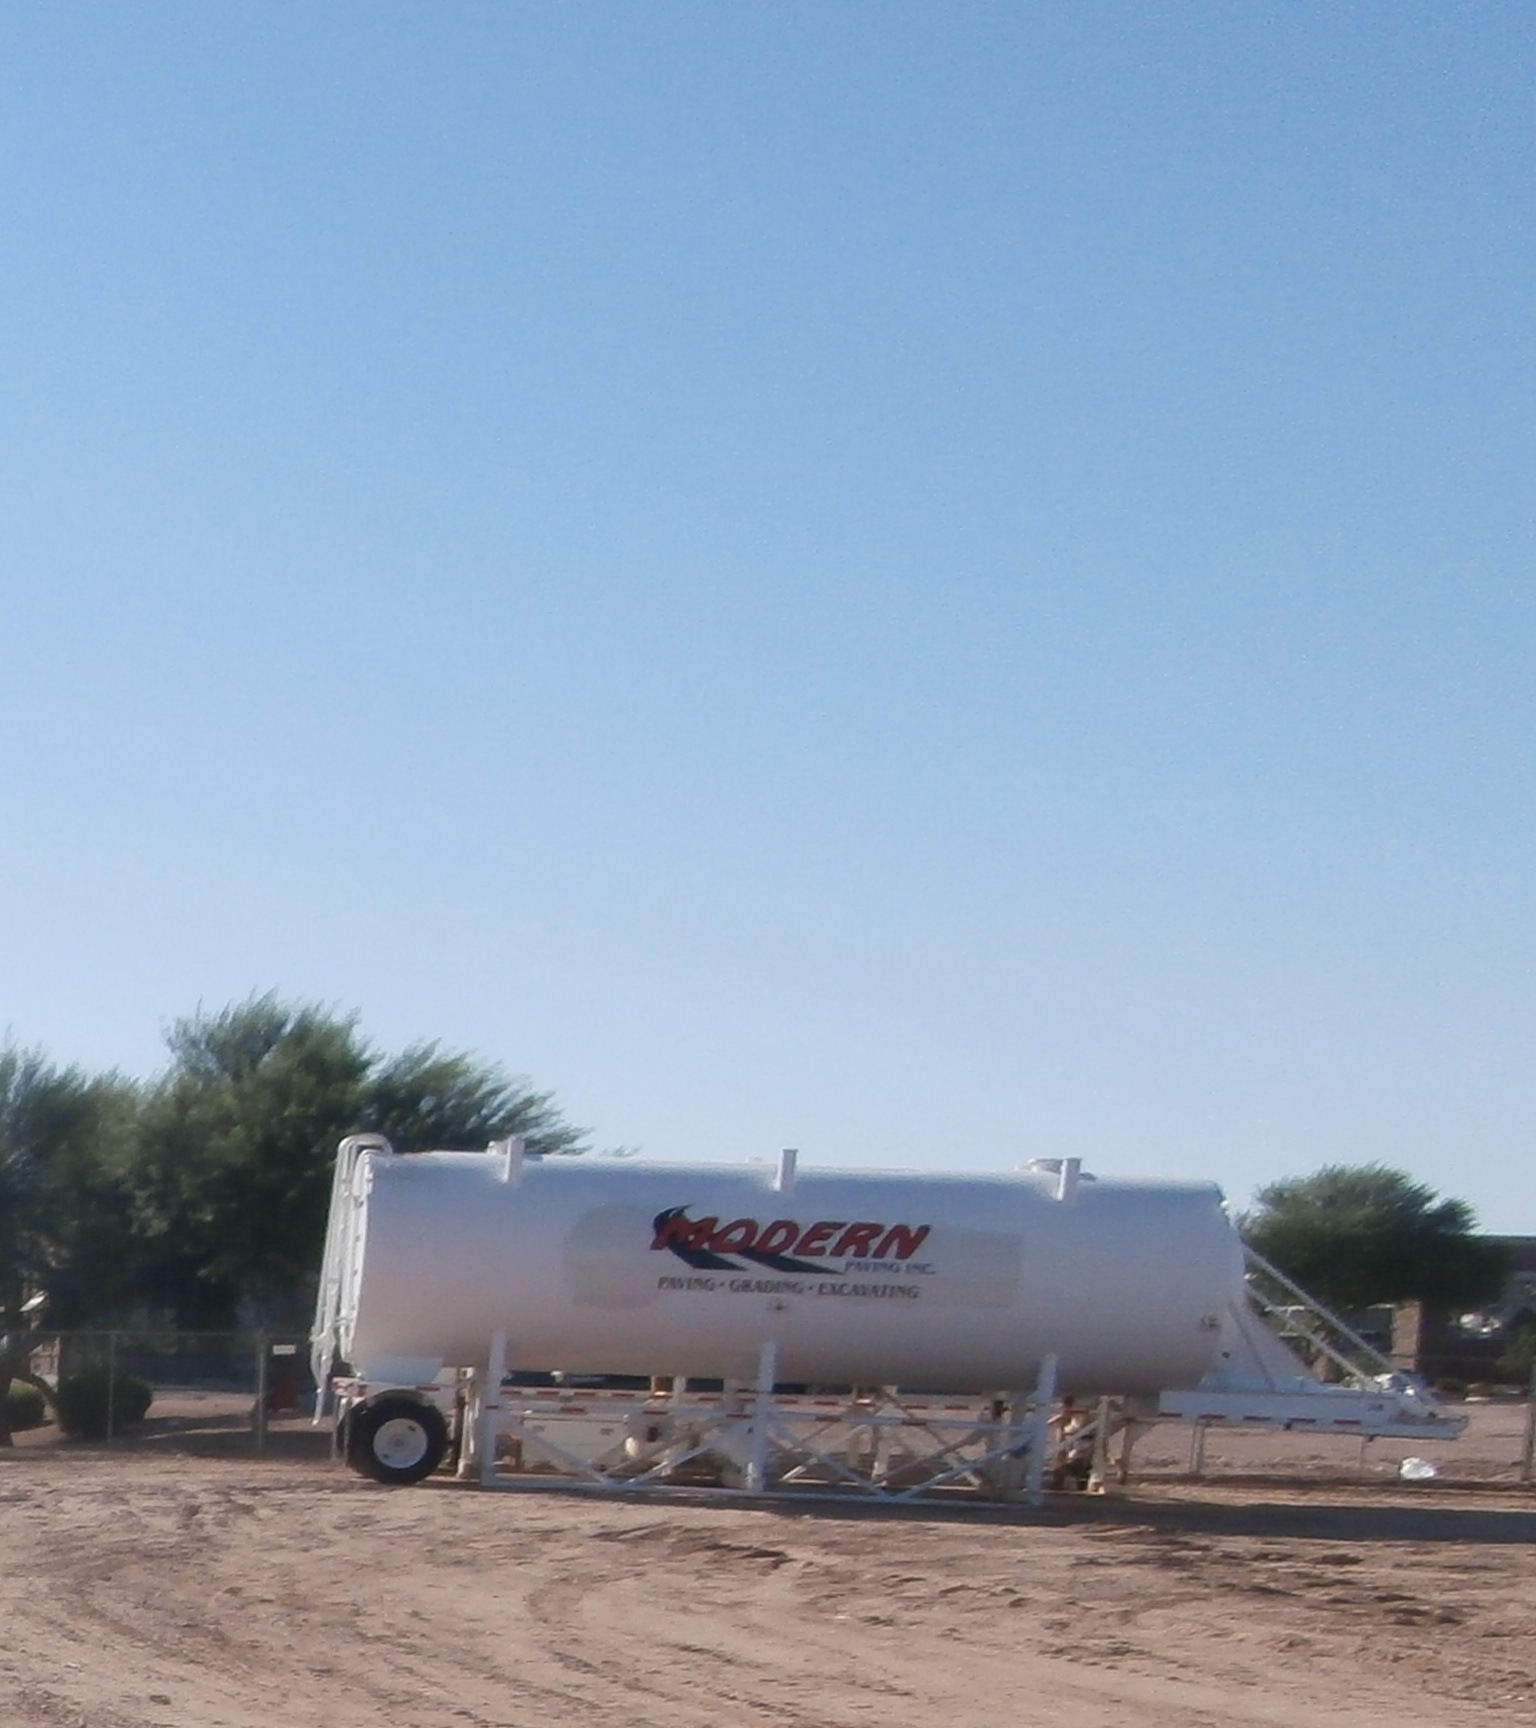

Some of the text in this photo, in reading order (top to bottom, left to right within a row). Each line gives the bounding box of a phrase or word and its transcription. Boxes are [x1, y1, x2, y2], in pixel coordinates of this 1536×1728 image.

[650, 1213, 932, 1260] MODERN
[657, 1276, 921, 1299] PAVING GRADING EXCAVATING
